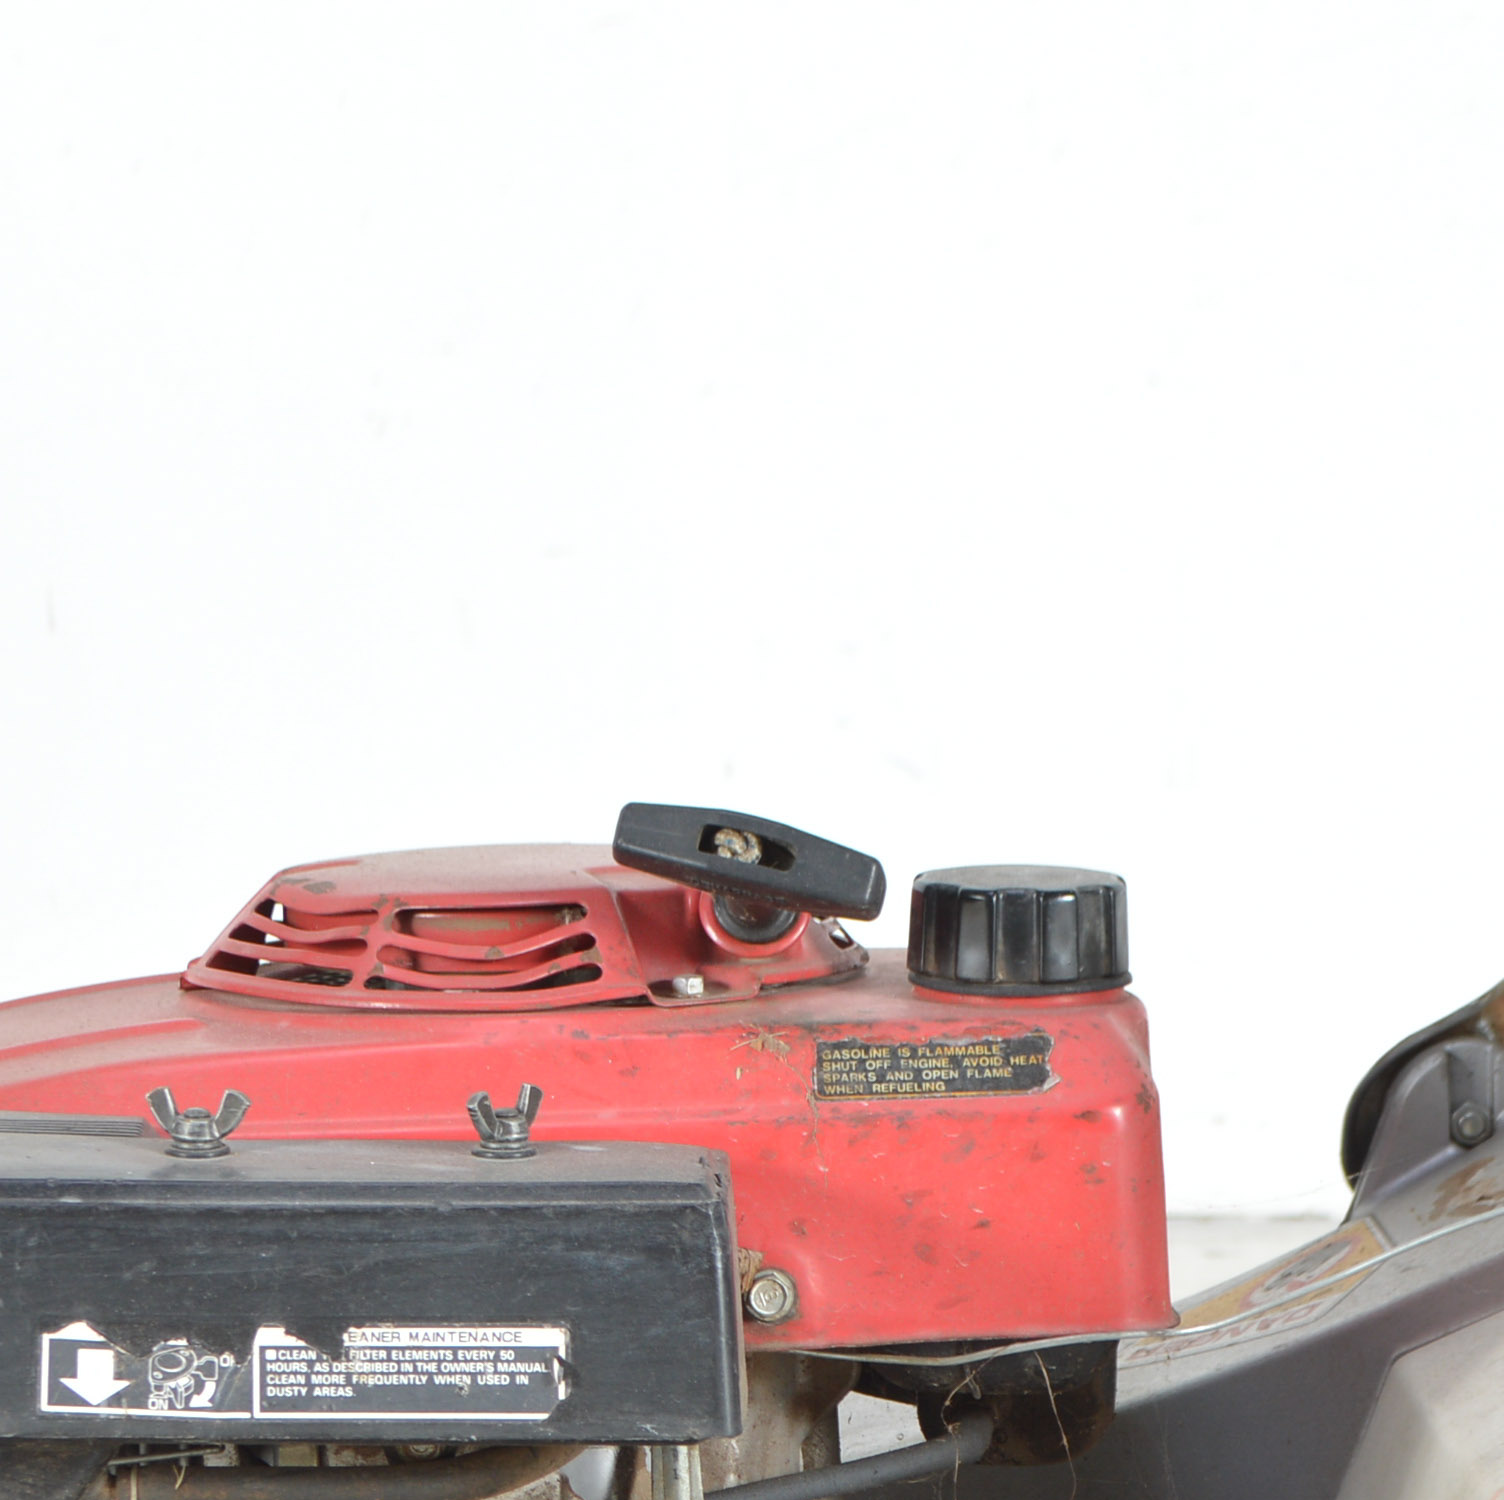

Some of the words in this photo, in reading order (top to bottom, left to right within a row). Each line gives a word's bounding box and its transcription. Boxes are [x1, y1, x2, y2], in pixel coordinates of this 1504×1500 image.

[822, 1047, 890, 1060] GASOLINE
[898, 1047, 911, 1058] IS
[918, 1044, 1001, 1057] FLAMMABLE
[822, 1060, 857, 1072] SHUT
[866, 1060, 892, 1070] OFF
[963, 1056, 1003, 1067] AVOID
[1010, 1054, 1044, 1066] HEAT
[823, 1071, 877, 1083] SPARKS
[886, 1070, 913, 1081] AND
[922, 1069, 959, 1080] OPEN
[967, 1067, 1013, 1079] FLAME
[824, 1083, 864, 1095] WHEN
[872, 1081, 946, 1093] REFUELING
[348, 1331, 401, 1343] EANER
[409, 1331, 523, 1343] MAINTENANCE
[278, 1349, 317, 1361] CLEAN
[349, 1349, 387, 1361] FILTER
[391, 1349, 453, 1361] ELEMENTS
[457, 1349, 496, 1361] EVERY
[499, 1349, 515, 1361] 50
[313, 1362, 330, 1373] AS
[332, 1362, 397, 1373] DESCRIBED
[400, 1362, 414, 1373] IN
[416, 1362, 438, 1373] THE
[440, 1362, 495, 1373] OWNER'S
[266, 1374, 306, 1385] CLEAN
[311, 1374, 347, 1385] MORE
[352, 1374, 428, 1386] FREQUENTLY
[434, 1374, 471, 1386] WHEN
[477, 1374, 510, 1386] USED
[516, 1374, 529, 1386] IN
[266, 1386, 308, 1397] DUSTY
[313, 1386, 356, 1397] AREAS.
[148, 1398, 169, 1410] ON
